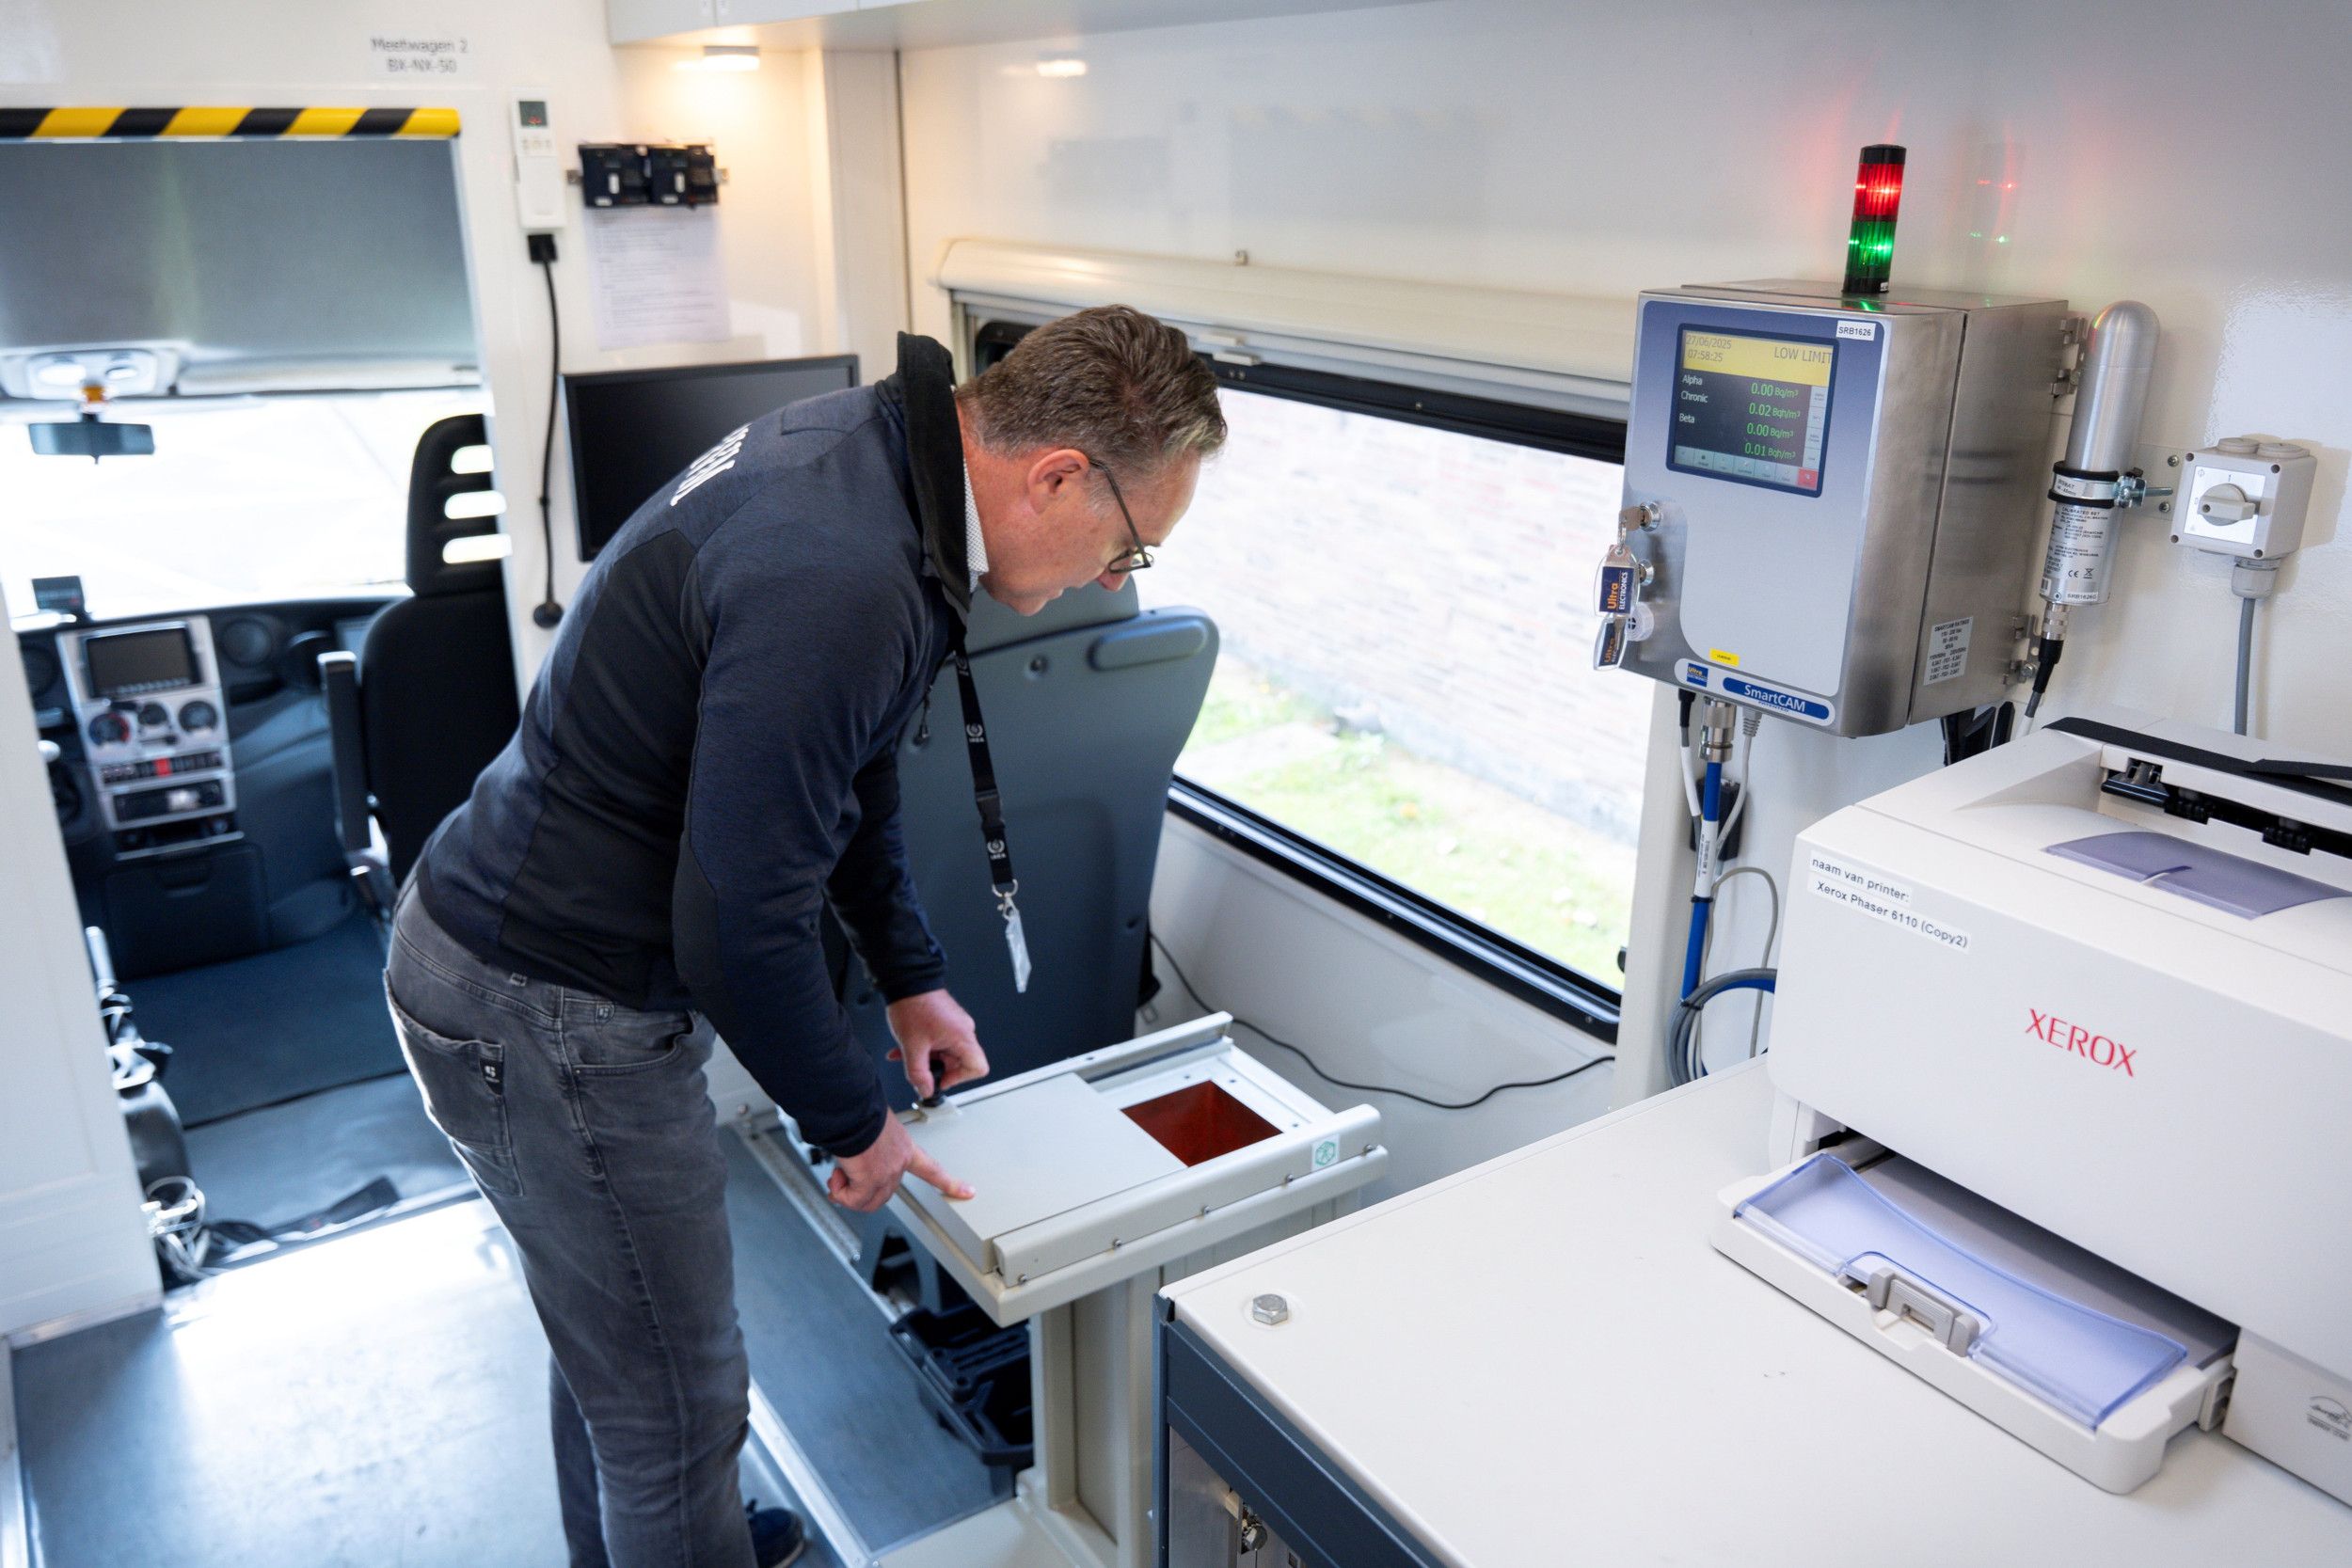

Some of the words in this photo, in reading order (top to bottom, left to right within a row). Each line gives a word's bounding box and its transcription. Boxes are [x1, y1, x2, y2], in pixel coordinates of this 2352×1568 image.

[369, 38, 454, 55] Meetwagen
[1838, 326, 1871, 337] SRB1626
[1773, 346, 1801, 360] LOW
[1682, 374, 1703, 387] Alpha
[1751, 382, 1774, 396] 0.00
[1680, 390, 1708, 404] Chronic
[1749, 403, 1772, 417] 0.02
[1678, 413, 1695, 424] Beta
[1746, 422, 1770, 436] 0.00
[1744, 442, 1767, 456] 0.01
[1607, 582, 1619, 610] Ultra
[1619, 572, 1629, 610] ELECTRONICS
[1744, 685, 1806, 712] SmartCAM
[1812, 858, 1841, 877] naam
[1845, 870, 1864, 885] van
[1867, 879, 1910, 903] printer:
[1817, 880, 1847, 901] Xerox
[1851, 895, 1888, 916] Phaser
[1891, 910, 1918, 928] 6110
[1920, 920, 1968, 949] (Copy2)
[2025, 1008, 2137, 1077] XEROX
